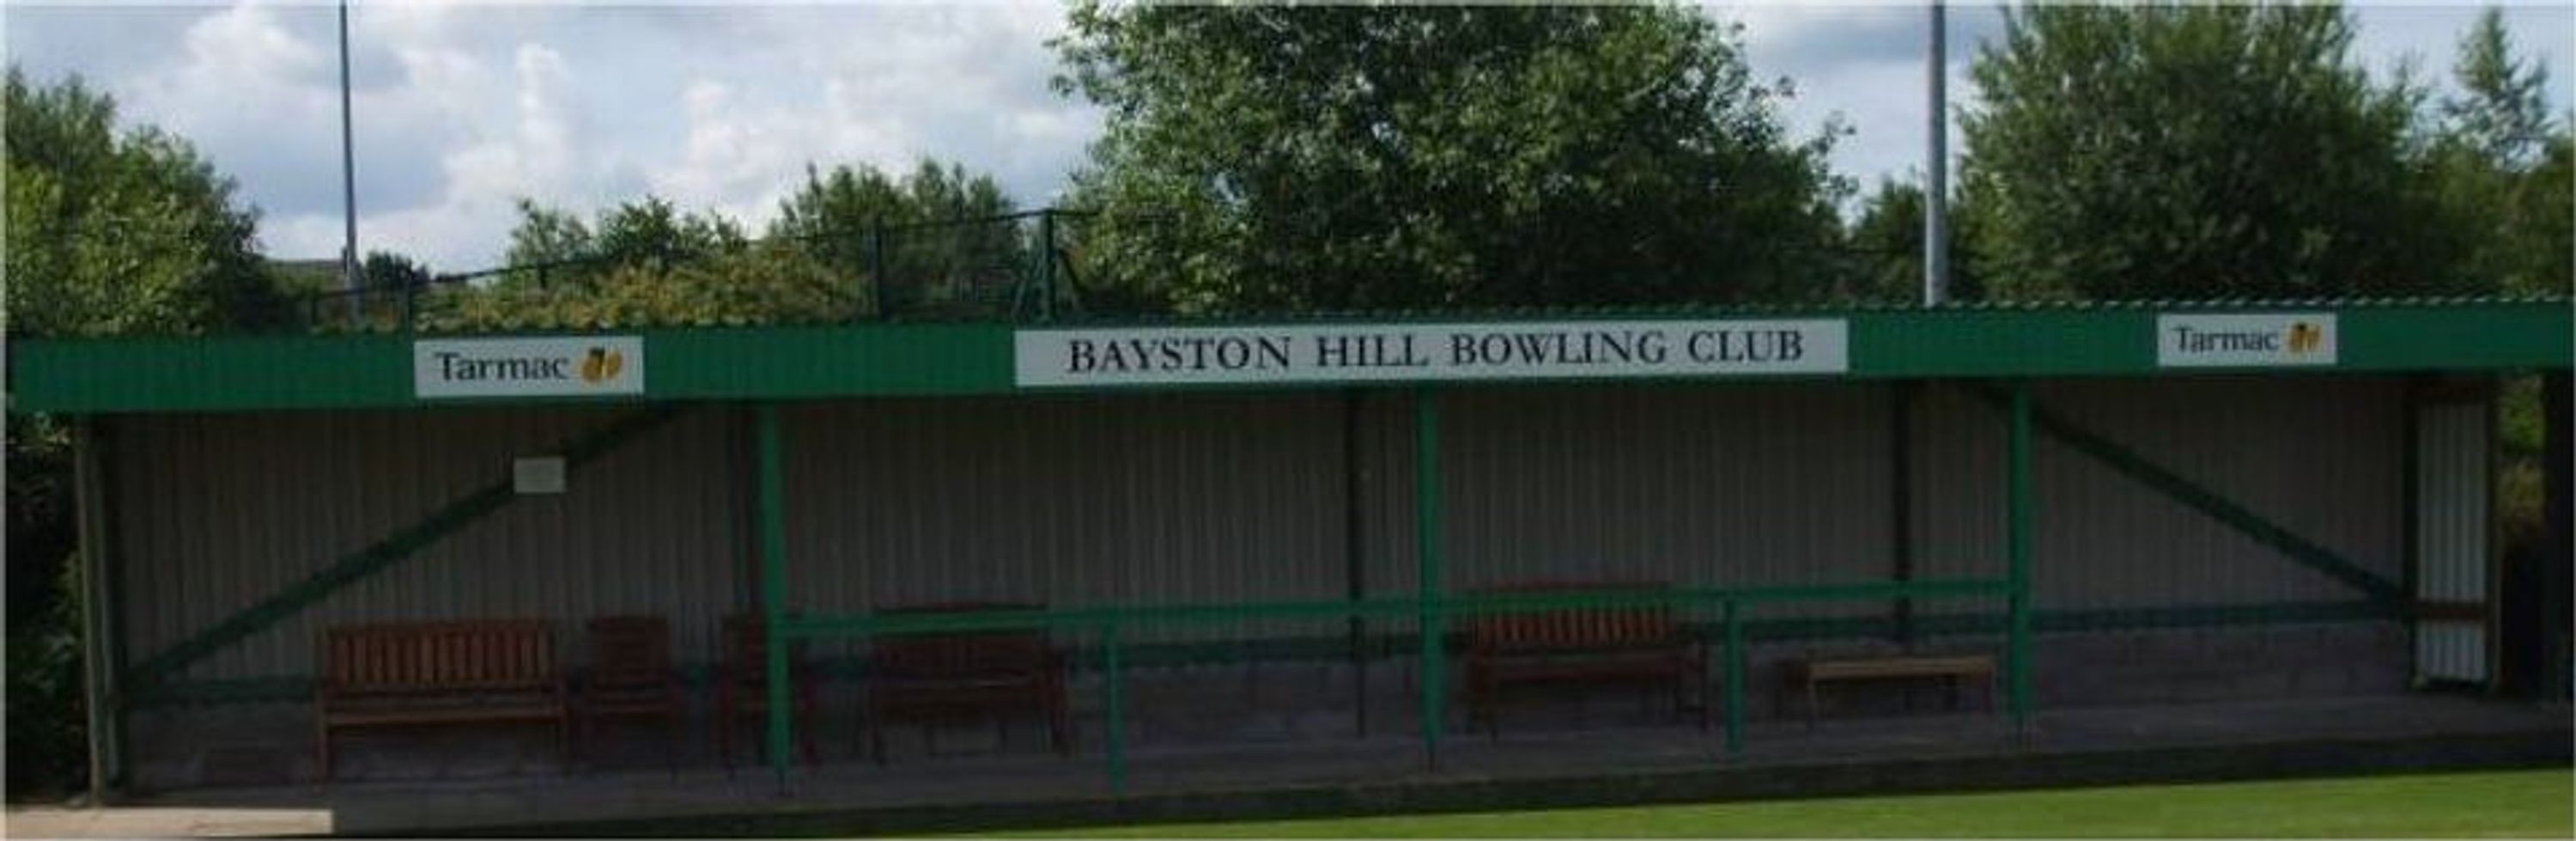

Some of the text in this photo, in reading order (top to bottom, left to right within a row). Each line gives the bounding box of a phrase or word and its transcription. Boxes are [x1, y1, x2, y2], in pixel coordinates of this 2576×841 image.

[1067, 329, 1803, 373] BAYSTON HILL BOWLING CLUB
[2172, 323, 2279, 353] Tarmac
[435, 351, 570, 381] Tarmac
